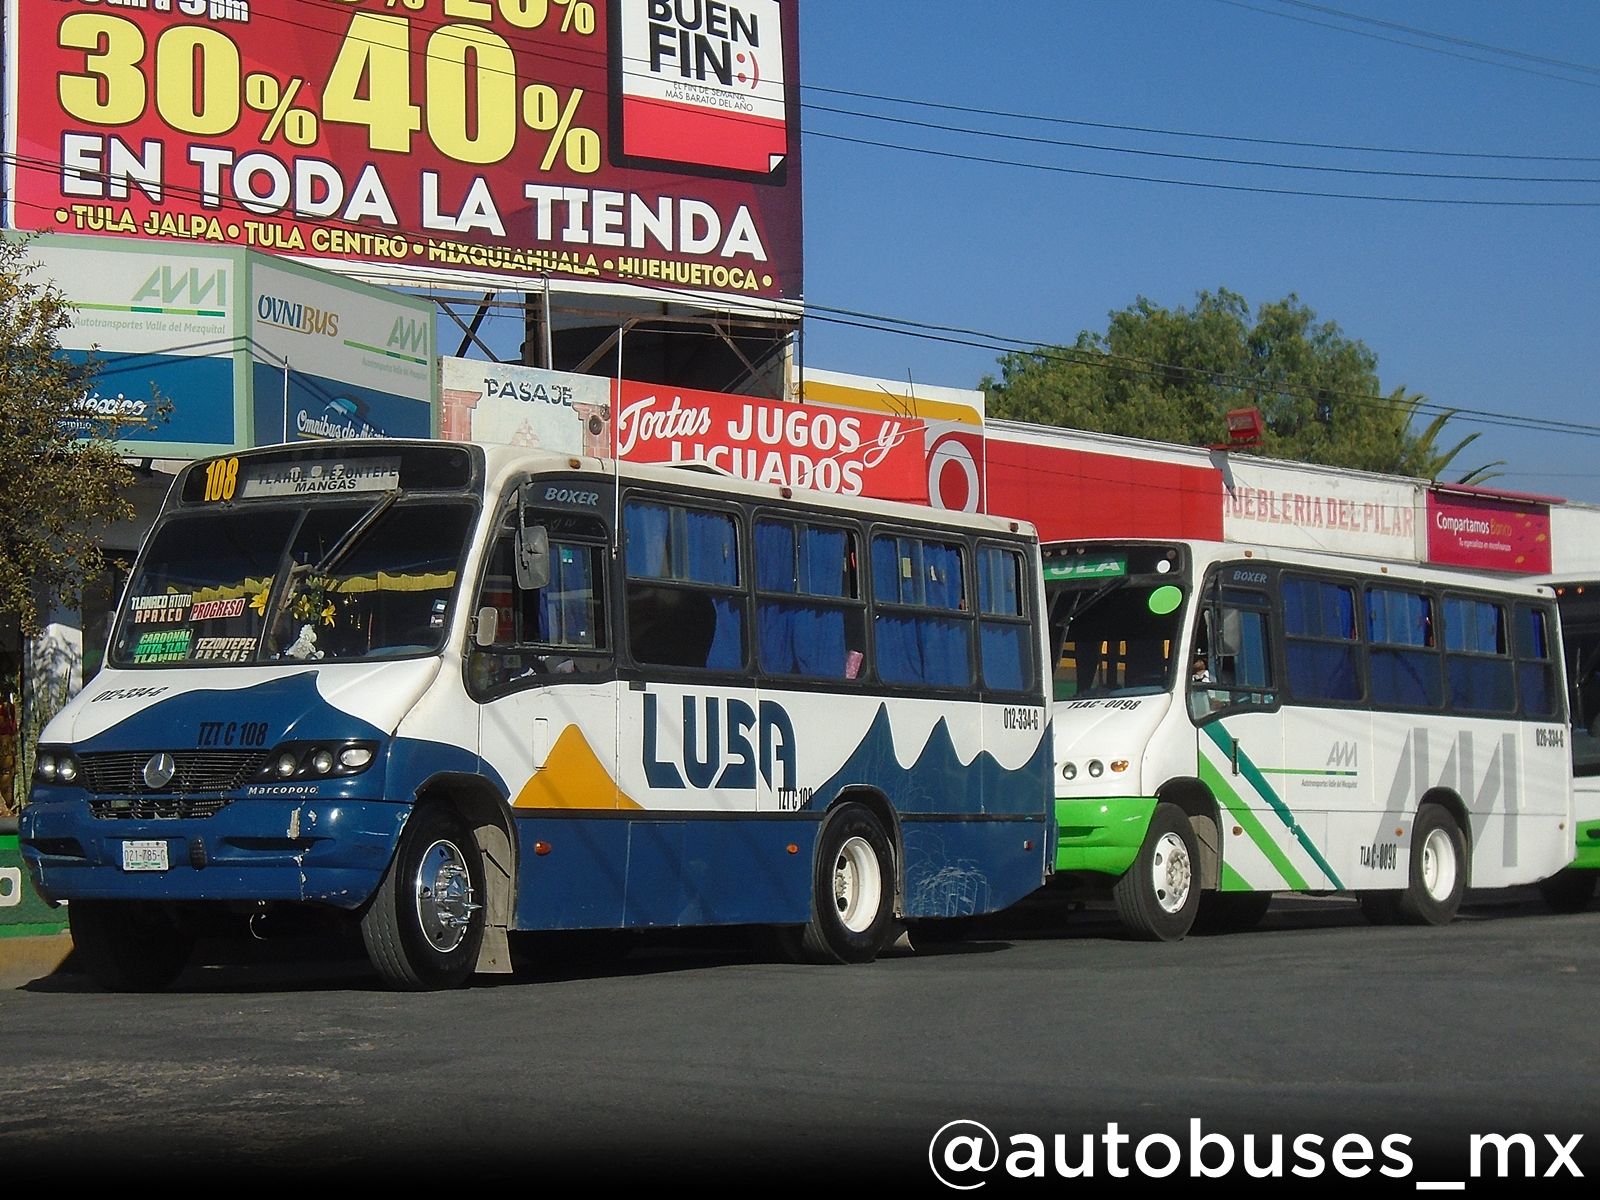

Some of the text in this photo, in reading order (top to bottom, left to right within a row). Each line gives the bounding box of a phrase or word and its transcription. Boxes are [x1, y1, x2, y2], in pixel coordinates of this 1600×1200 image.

[58, 12, 600, 174] 30% 40%
[686, 92, 717, 105] BARATO
[718, 98, 733, 109] DEL
[700, 85, 709, 95] DE
[63, 132, 767, 261] EN TODA LA TIENDA
[72, 205, 759, 291] TULA JALPA TULA CENTRO MIXQUIAHUALA HUEHUETOCA
[74, 317, 226, 336] Autotransportes Valle del Mezquital
[258, 294, 339, 337] OVNIBUS
[484, 378, 573, 407] PASAJE
[297, 409, 341, 439] Omnibus
[619, 396, 905, 469] Tortas JUGOS y
[205, 457, 239, 501] 108
[295, 479, 356, 493] MANGAS
[544, 487, 599, 506] BOXER
[1326, 497, 1361, 533] DEL
[1363, 502, 1415, 538] PILAR
[1436, 512, 1490, 535] Compartamos
[1233, 570, 1268, 584] BOXER
[135, 608, 183, 623] APAXCO
[190, 599, 243, 619] PROGRESO
[1004, 707, 1039, 730] 012-334-G
[197, 722, 269, 747] TZT C 108
[642, 692, 799, 794] LUSA
[248, 785, 318, 795] Marcopolo
[778, 787, 790, 810] TZT
[792, 789, 798, 810] C
[125, 849, 166, 862] 021-785-G
